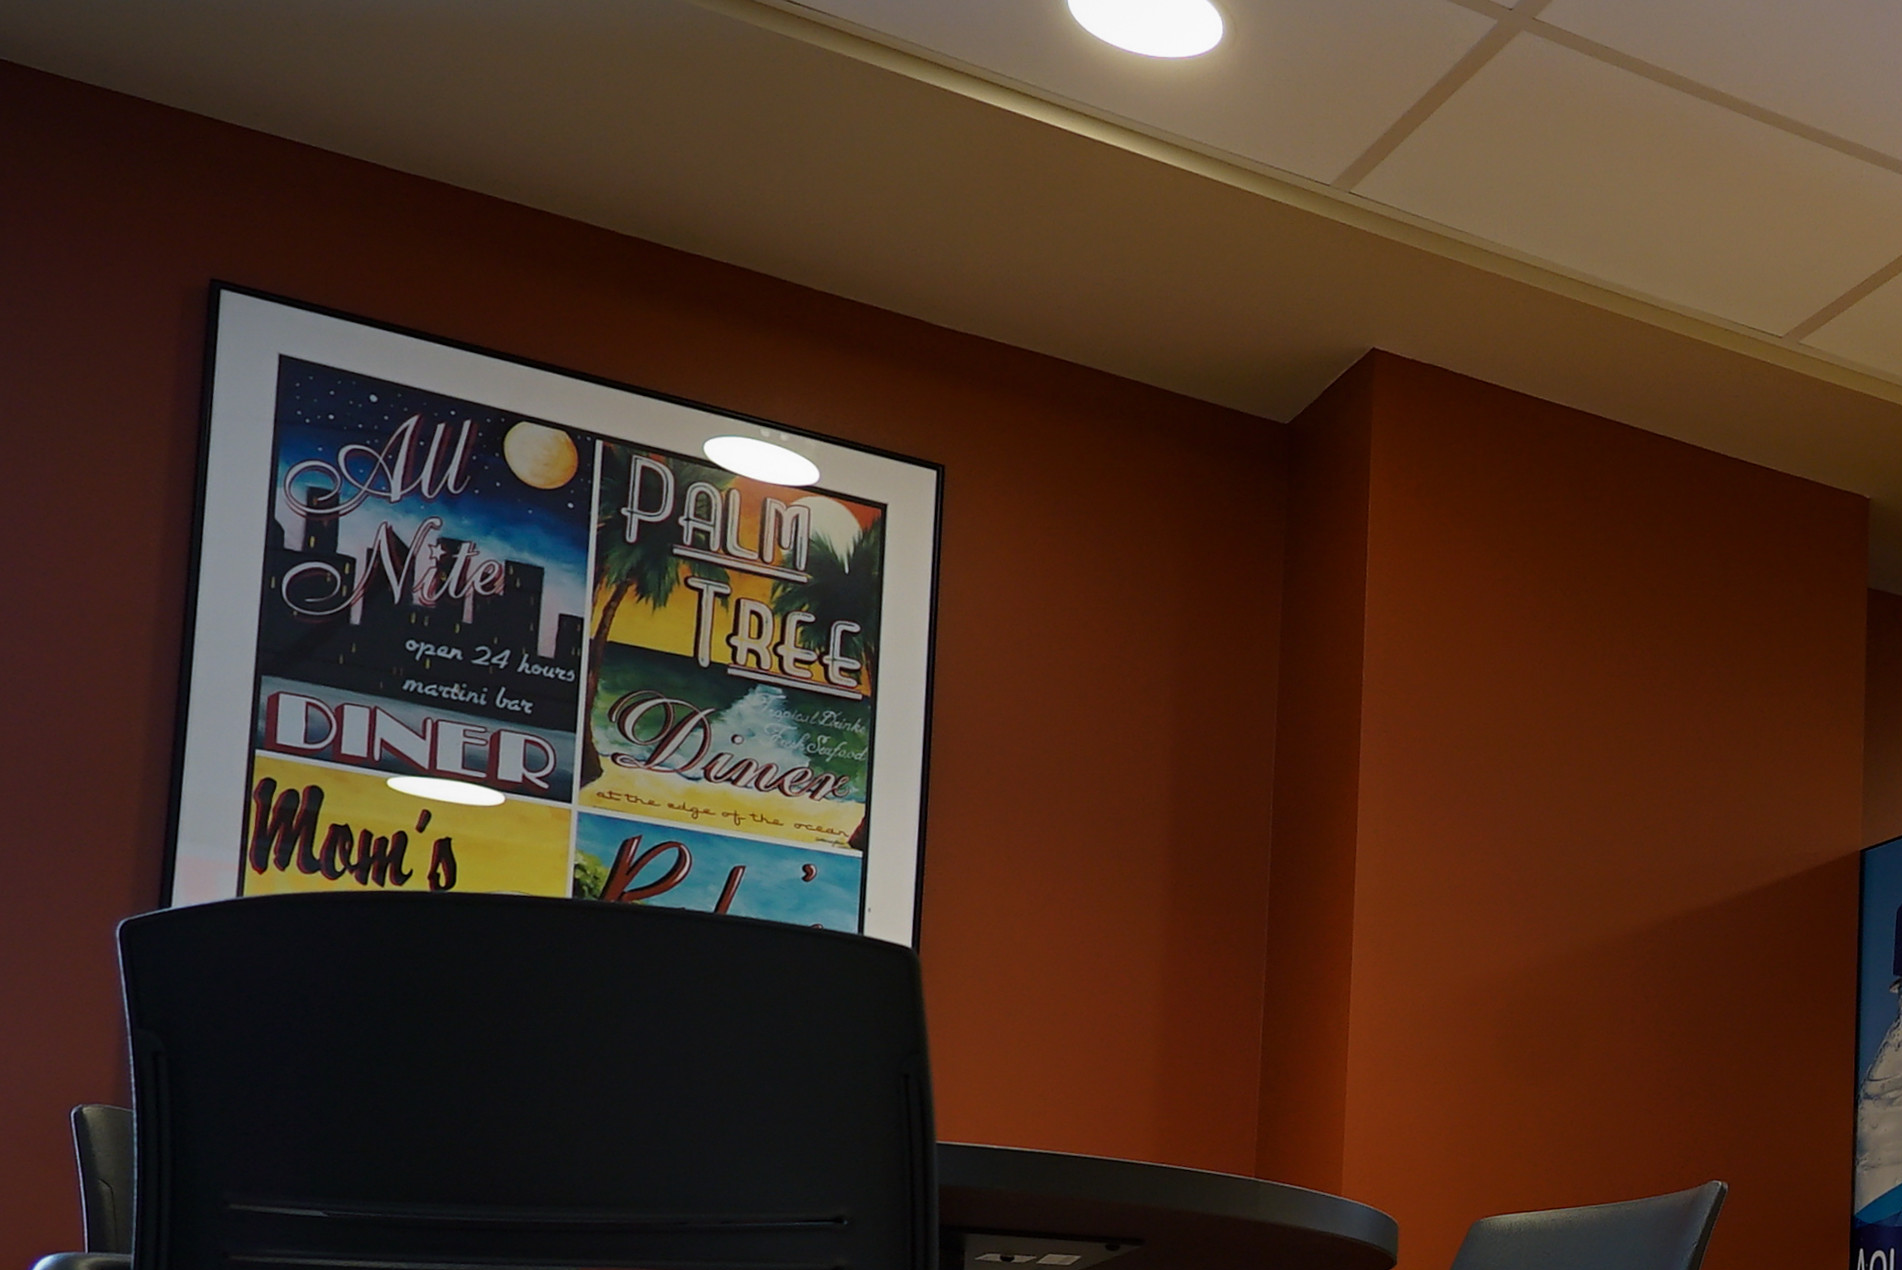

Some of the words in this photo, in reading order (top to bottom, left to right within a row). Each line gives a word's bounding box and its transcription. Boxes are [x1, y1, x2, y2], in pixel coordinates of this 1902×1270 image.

[284, 414, 474, 516] All
[621, 455, 810, 572] PALM
[282, 516, 505, 617] Nite
[405, 638, 464, 661] open
[471, 646, 510, 669] 24
[517, 653, 576, 682] hours
[683, 576, 861, 688] TREE
[265, 691, 557, 790] DINER
[402, 677, 488, 706] martini
[495, 687, 534, 714] bar
[608, 690, 851, 801] Diner
[250, 777, 457, 892] Mom's
[596, 789, 621, 802] at
[624, 792, 661, 807] the
[667, 801, 716, 819] edge
[721, 809, 745, 825] of
[750, 811, 784, 826] the
[794, 821, 849, 838] ocean
